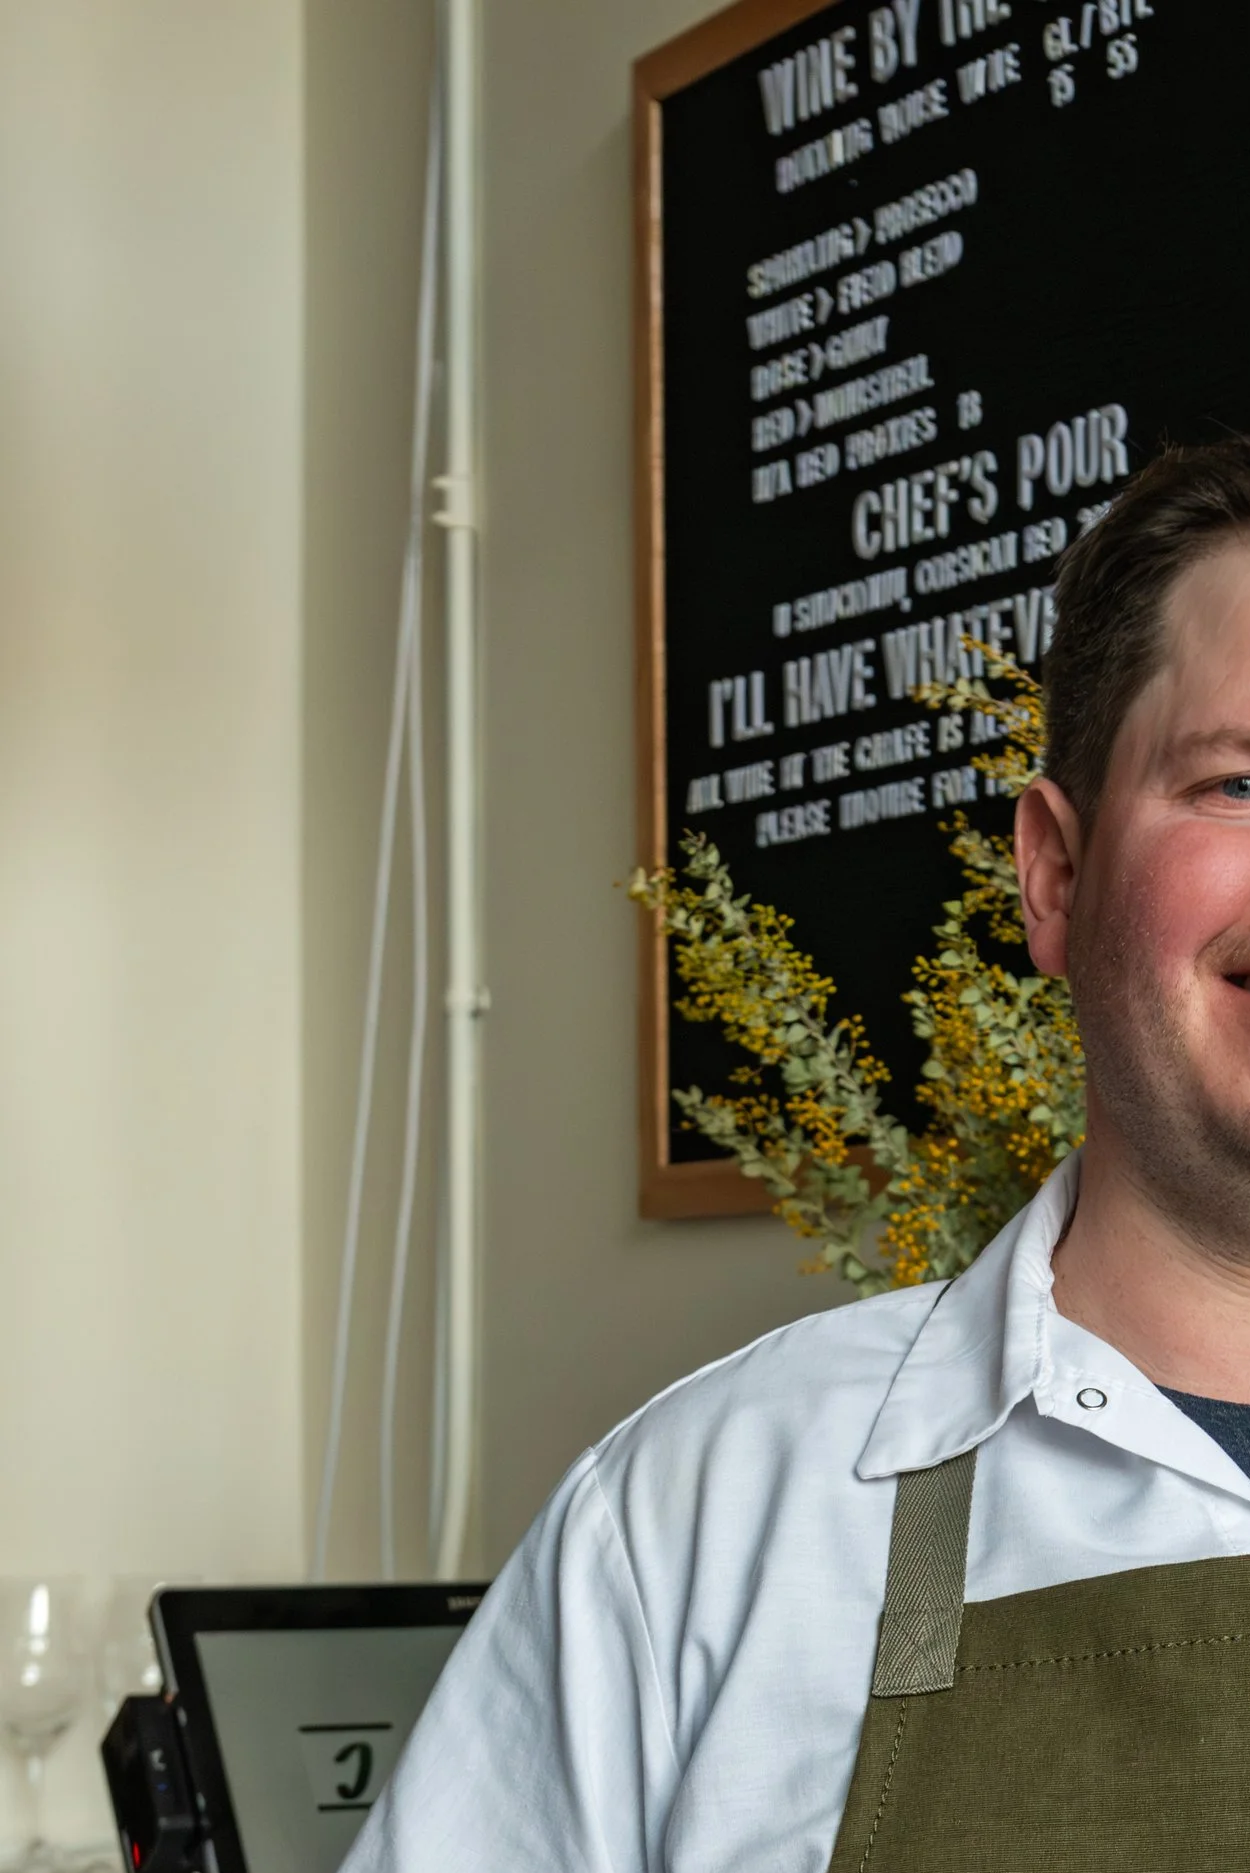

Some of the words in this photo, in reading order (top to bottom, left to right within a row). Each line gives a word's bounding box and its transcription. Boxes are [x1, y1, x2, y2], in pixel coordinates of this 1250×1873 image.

[758, 25, 859, 136] WINE
[869, 0, 920, 84] BY
[852, 451, 998, 560] CHEF'S
[1017, 403, 1130, 511] POUR
[708, 670, 774, 749] I'LL
[783, 638, 877, 729] HAVE
[937, 712, 964, 752] IS
[755, 798, 831, 849] PLEASE
